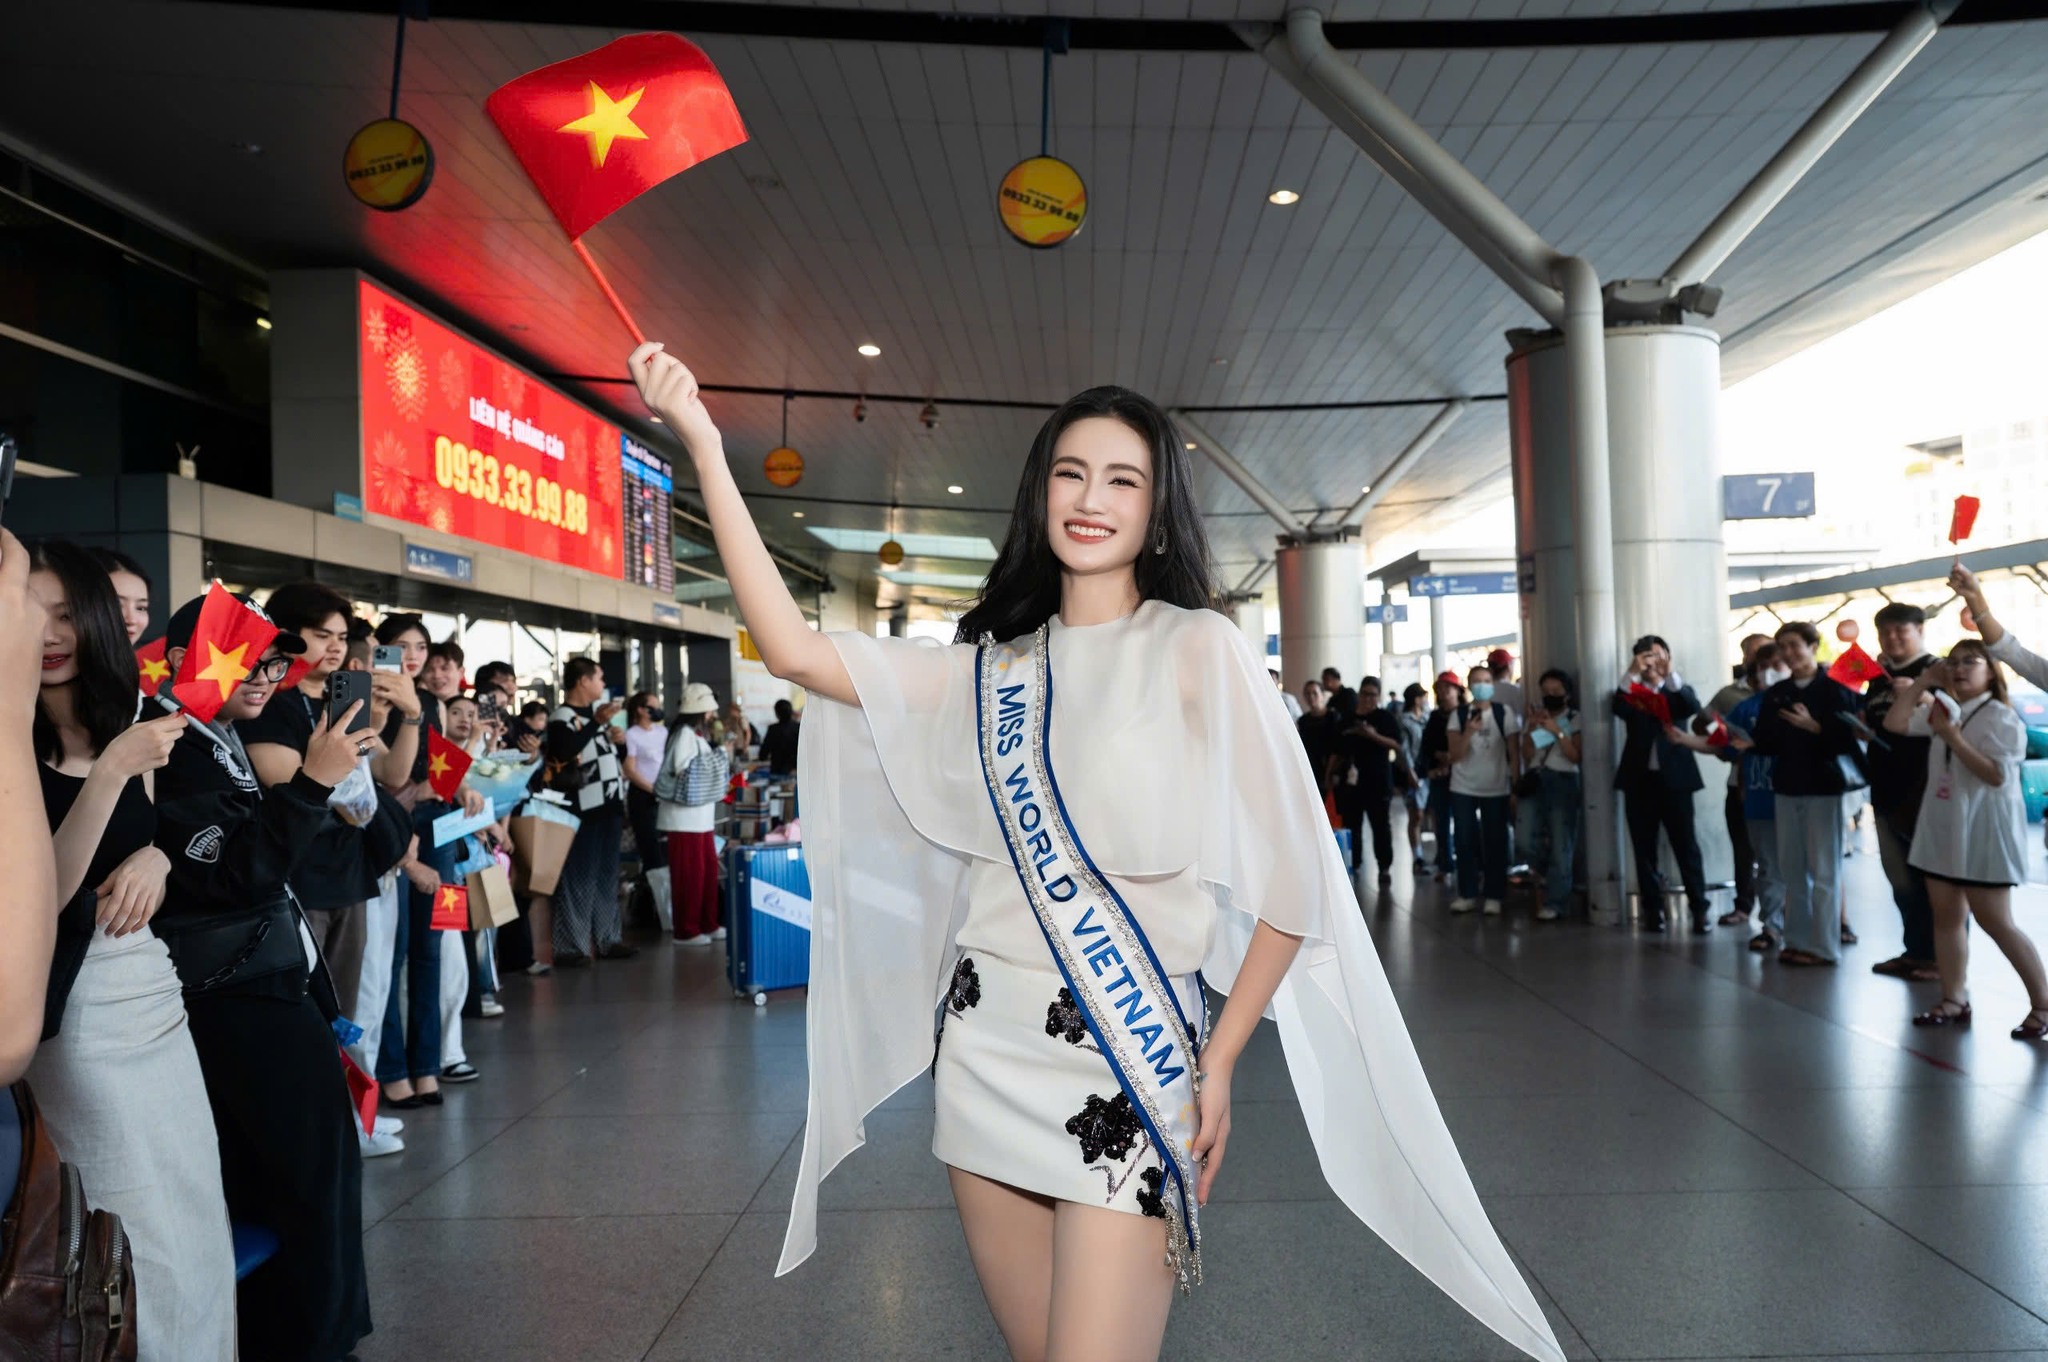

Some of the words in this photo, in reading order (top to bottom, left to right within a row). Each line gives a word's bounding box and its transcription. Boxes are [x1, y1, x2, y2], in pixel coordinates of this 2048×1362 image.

[435, 435, 588, 535] 0933.33.99.88
[1756, 478, 1782, 512] 7
[996, 683, 1026, 757] MISS
[1005, 762, 1078, 903] WORLD
[1072, 905, 1185, 1089] VIETNAM
